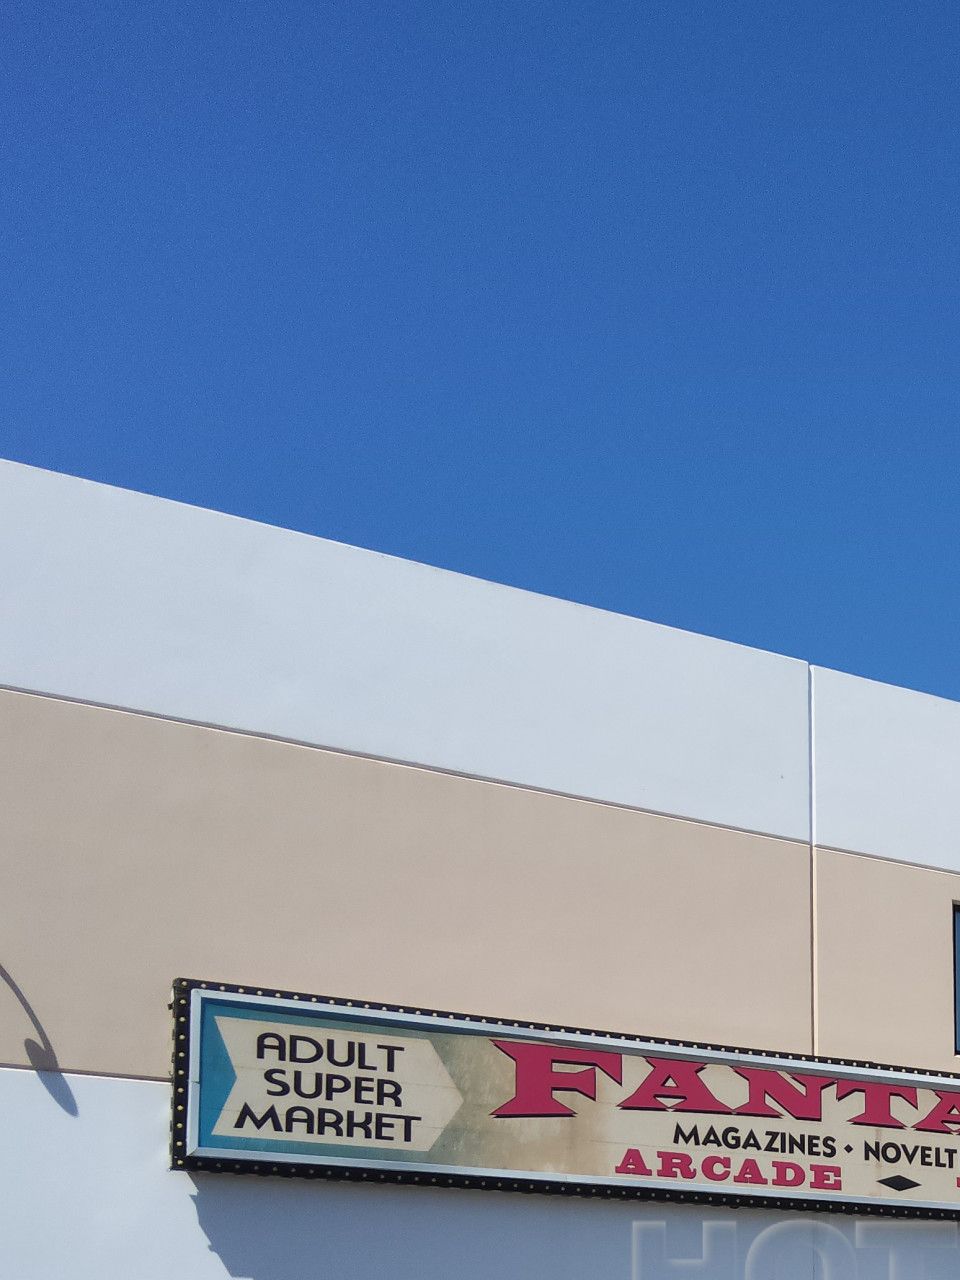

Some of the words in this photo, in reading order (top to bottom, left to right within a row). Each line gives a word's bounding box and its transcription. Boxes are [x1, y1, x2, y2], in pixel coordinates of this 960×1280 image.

[256, 1032, 405, 1073] ADULT
[263, 1068, 403, 1108] SUPER
[233, 1102, 421, 1143] MARKET
[673, 1123, 836, 1158] MAGAZINES
[615, 1148, 842, 1191] ARCADE
